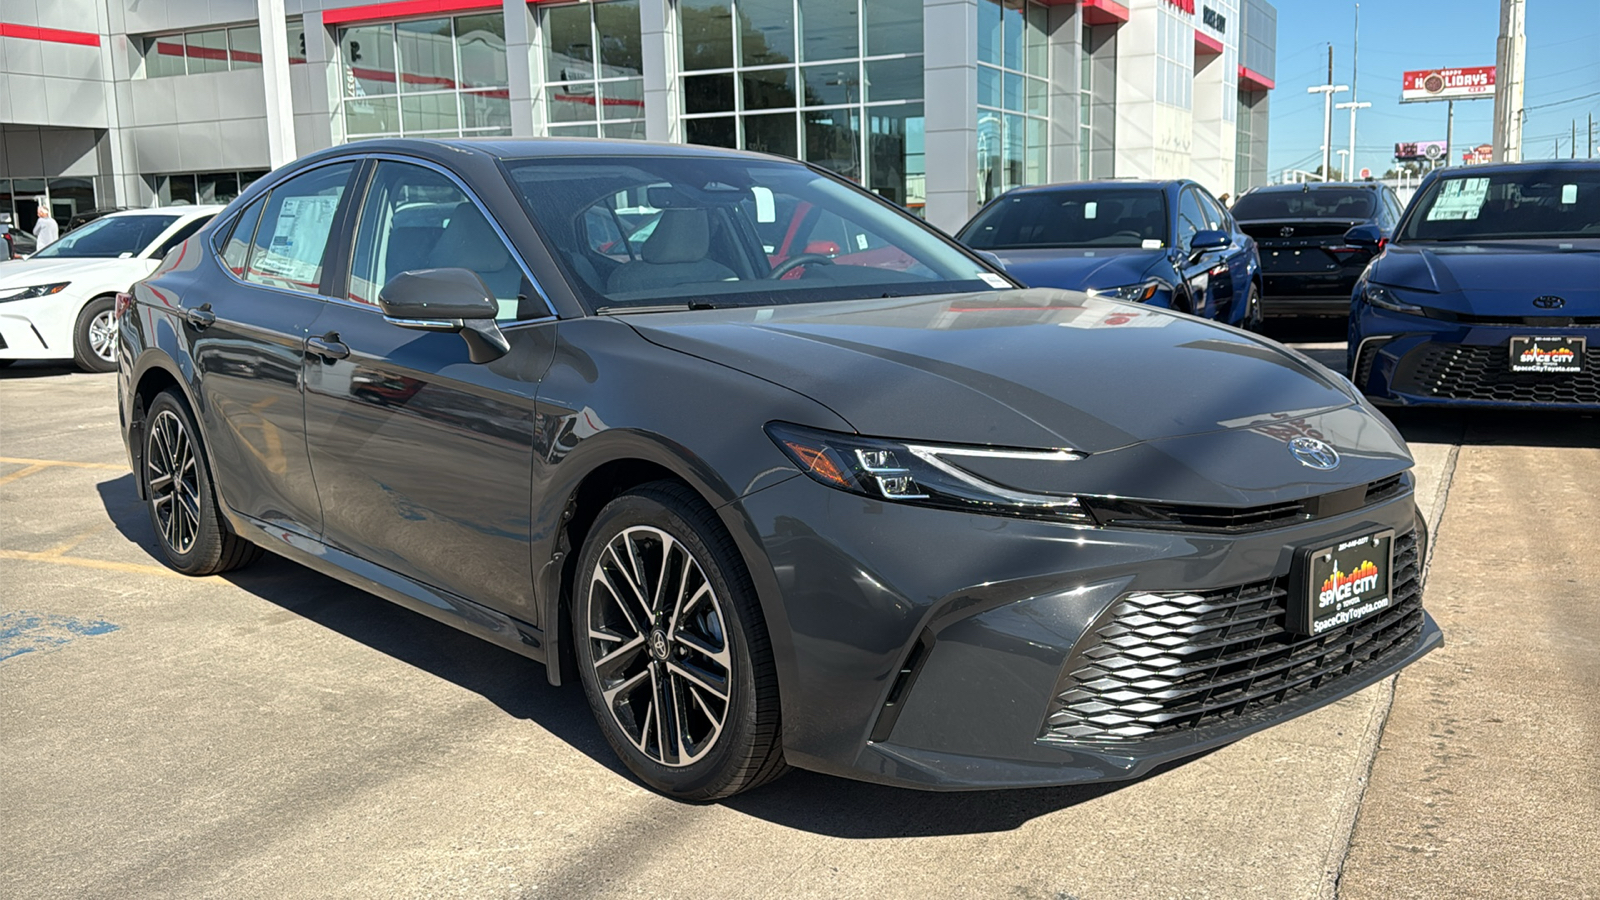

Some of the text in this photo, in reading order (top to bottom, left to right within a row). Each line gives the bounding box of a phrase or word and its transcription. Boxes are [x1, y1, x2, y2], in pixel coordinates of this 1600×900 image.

[1552, 354, 1575, 363] CITY
[1319, 574, 1379, 608] SPACE CITY
[1342, 596, 1361, 608] TOYOTA
[1313, 597, 1389, 633] SpaceCityToyota.com
